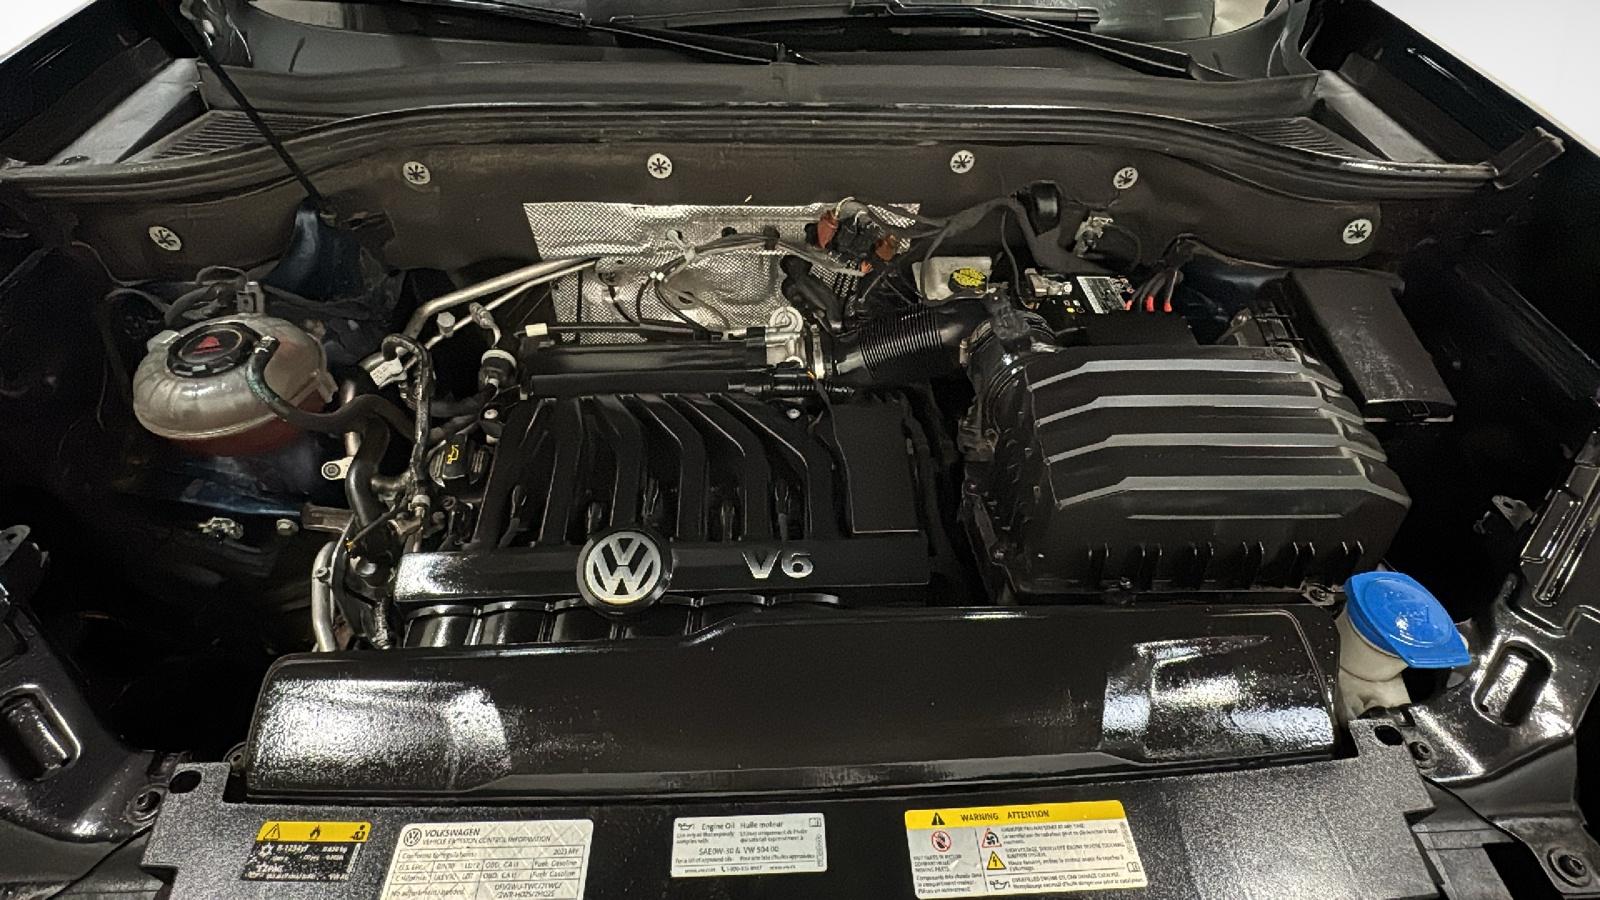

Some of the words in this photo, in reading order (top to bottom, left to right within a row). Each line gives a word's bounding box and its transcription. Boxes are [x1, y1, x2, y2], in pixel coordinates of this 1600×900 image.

[742, 550, 814, 579] V6
[960, 813, 999, 821] WARNING
[1007, 810, 1049, 820] ATTENTION
[702, 823, 723, 832] Engine
[425, 828, 480, 837] VOLKSWAGEN
[743, 846, 755, 854] VW
[549, 870, 576, 878] Gasoline
